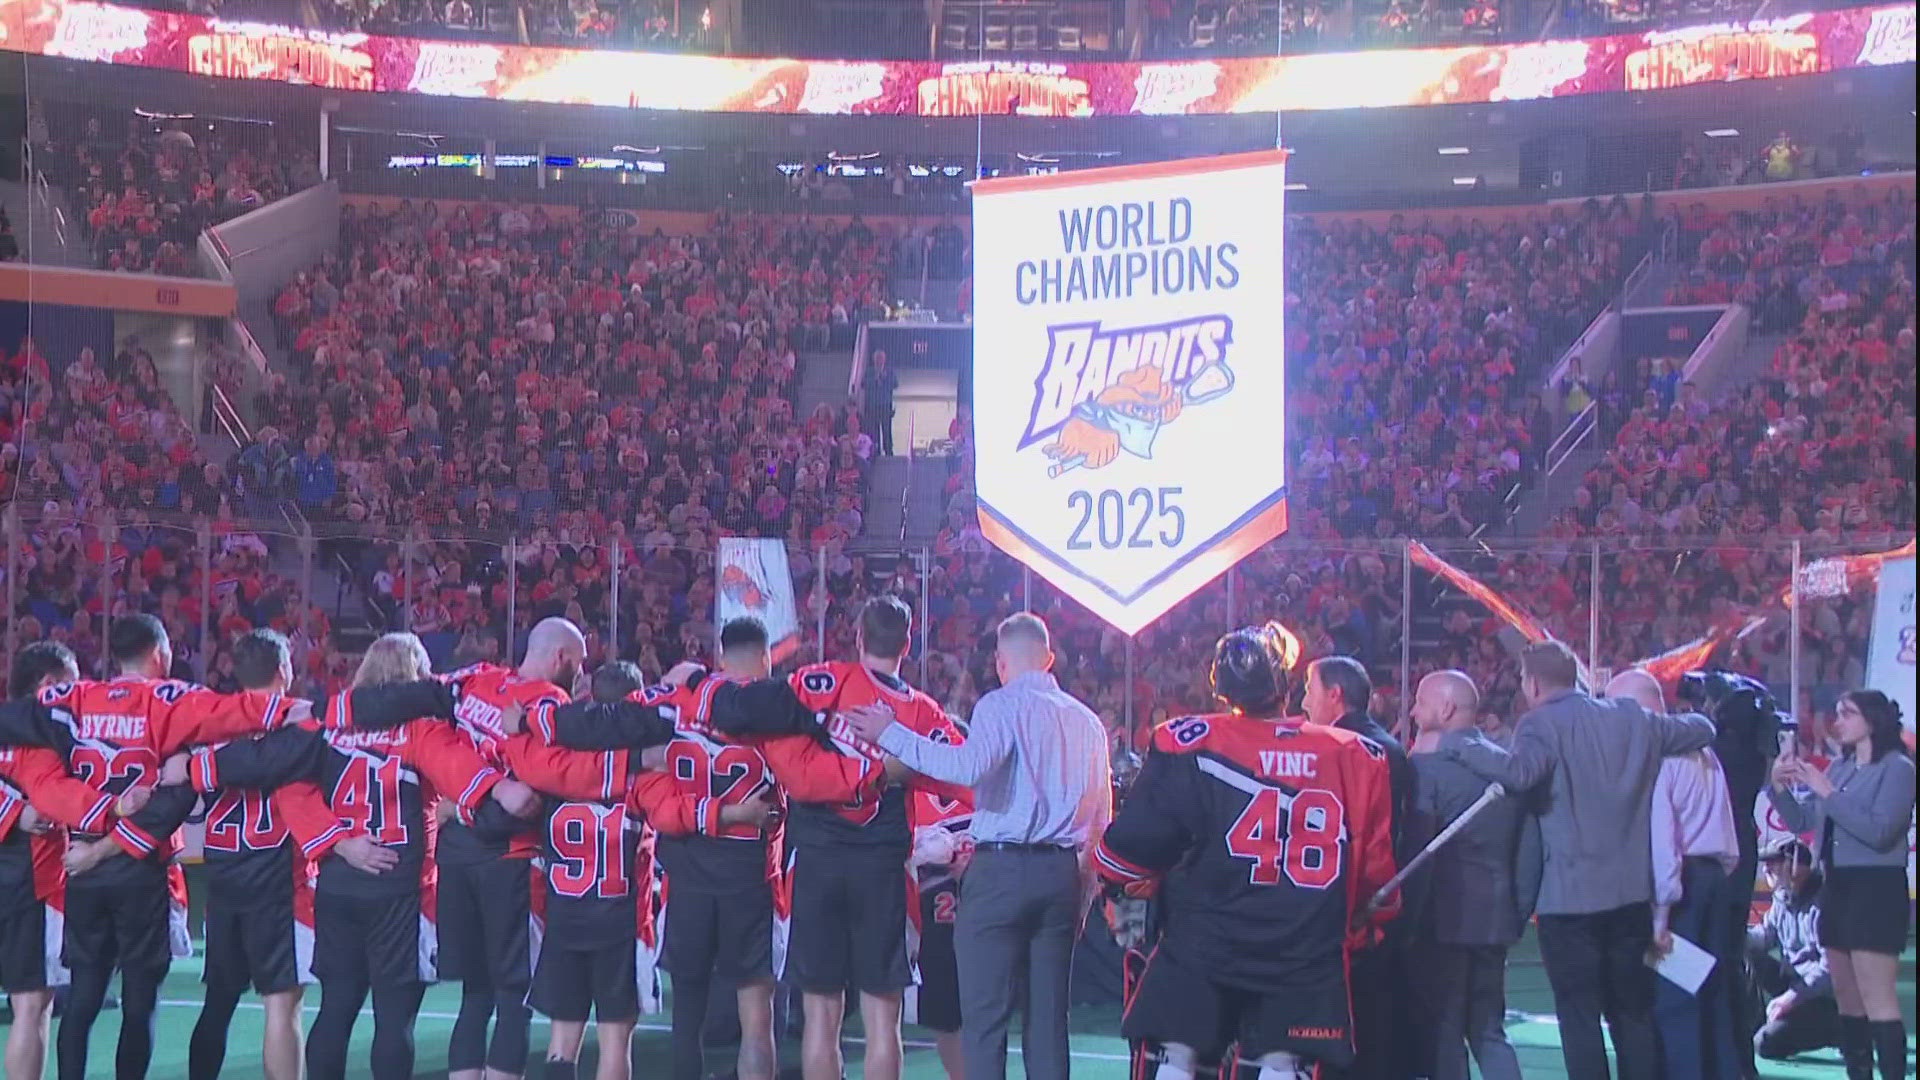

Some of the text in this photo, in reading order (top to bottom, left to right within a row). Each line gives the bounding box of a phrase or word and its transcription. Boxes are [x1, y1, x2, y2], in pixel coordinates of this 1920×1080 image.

[918, 72, 1094, 117] CHAMPIONS
[1058, 197, 1192, 254] WORLD
[1015, 243, 1240, 304] CHAMPIONS
[1020, 314, 1233, 447] BANDITS
[1066, 486, 1185, 551] 2025
[81, 714, 147, 740] BYRNE
[459, 693, 509, 740] PRIOL
[1258, 750, 1318, 778] VINC
[204, 787, 290, 852] 20
[331, 755, 408, 846] 41
[549, 802, 629, 898] 91
[1225, 787, 1346, 890] 48
